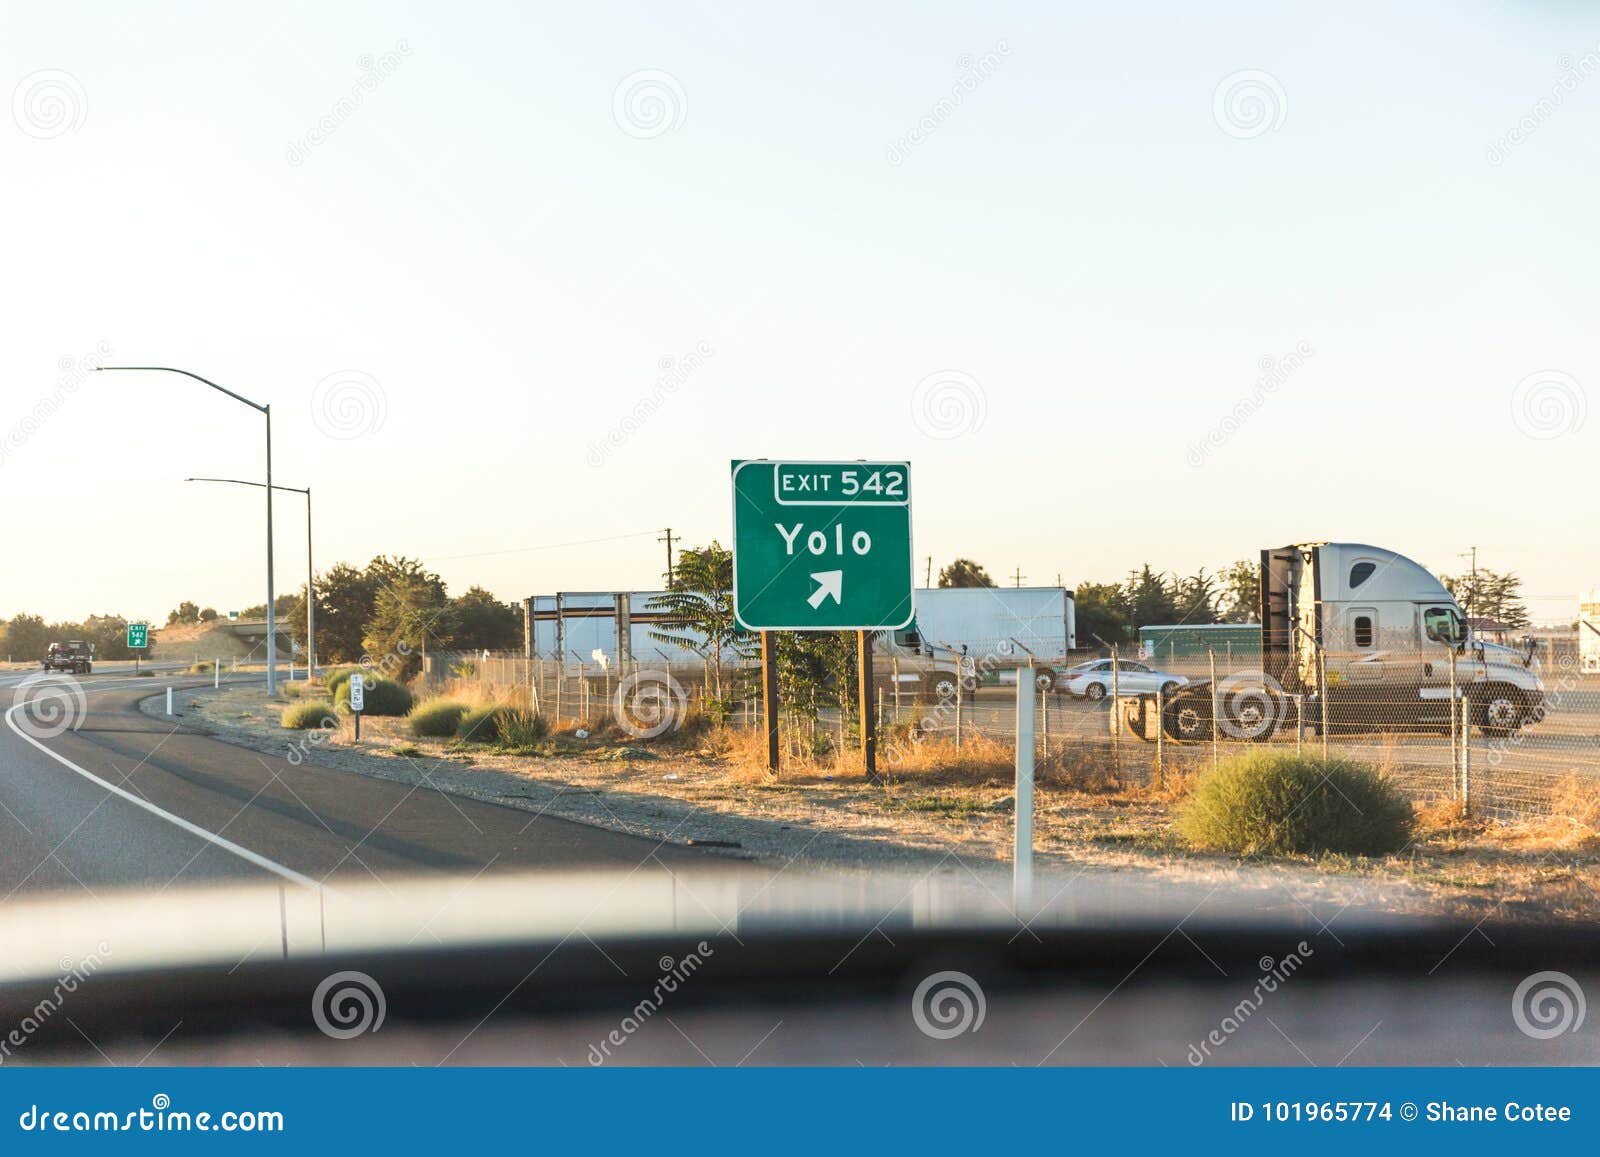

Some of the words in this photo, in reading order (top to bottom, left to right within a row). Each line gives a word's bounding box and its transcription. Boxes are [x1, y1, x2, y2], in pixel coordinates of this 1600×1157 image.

[782, 474, 832, 491] EXIT
[841, 471, 904, 495] 542
[774, 522, 872, 556] Yolo
